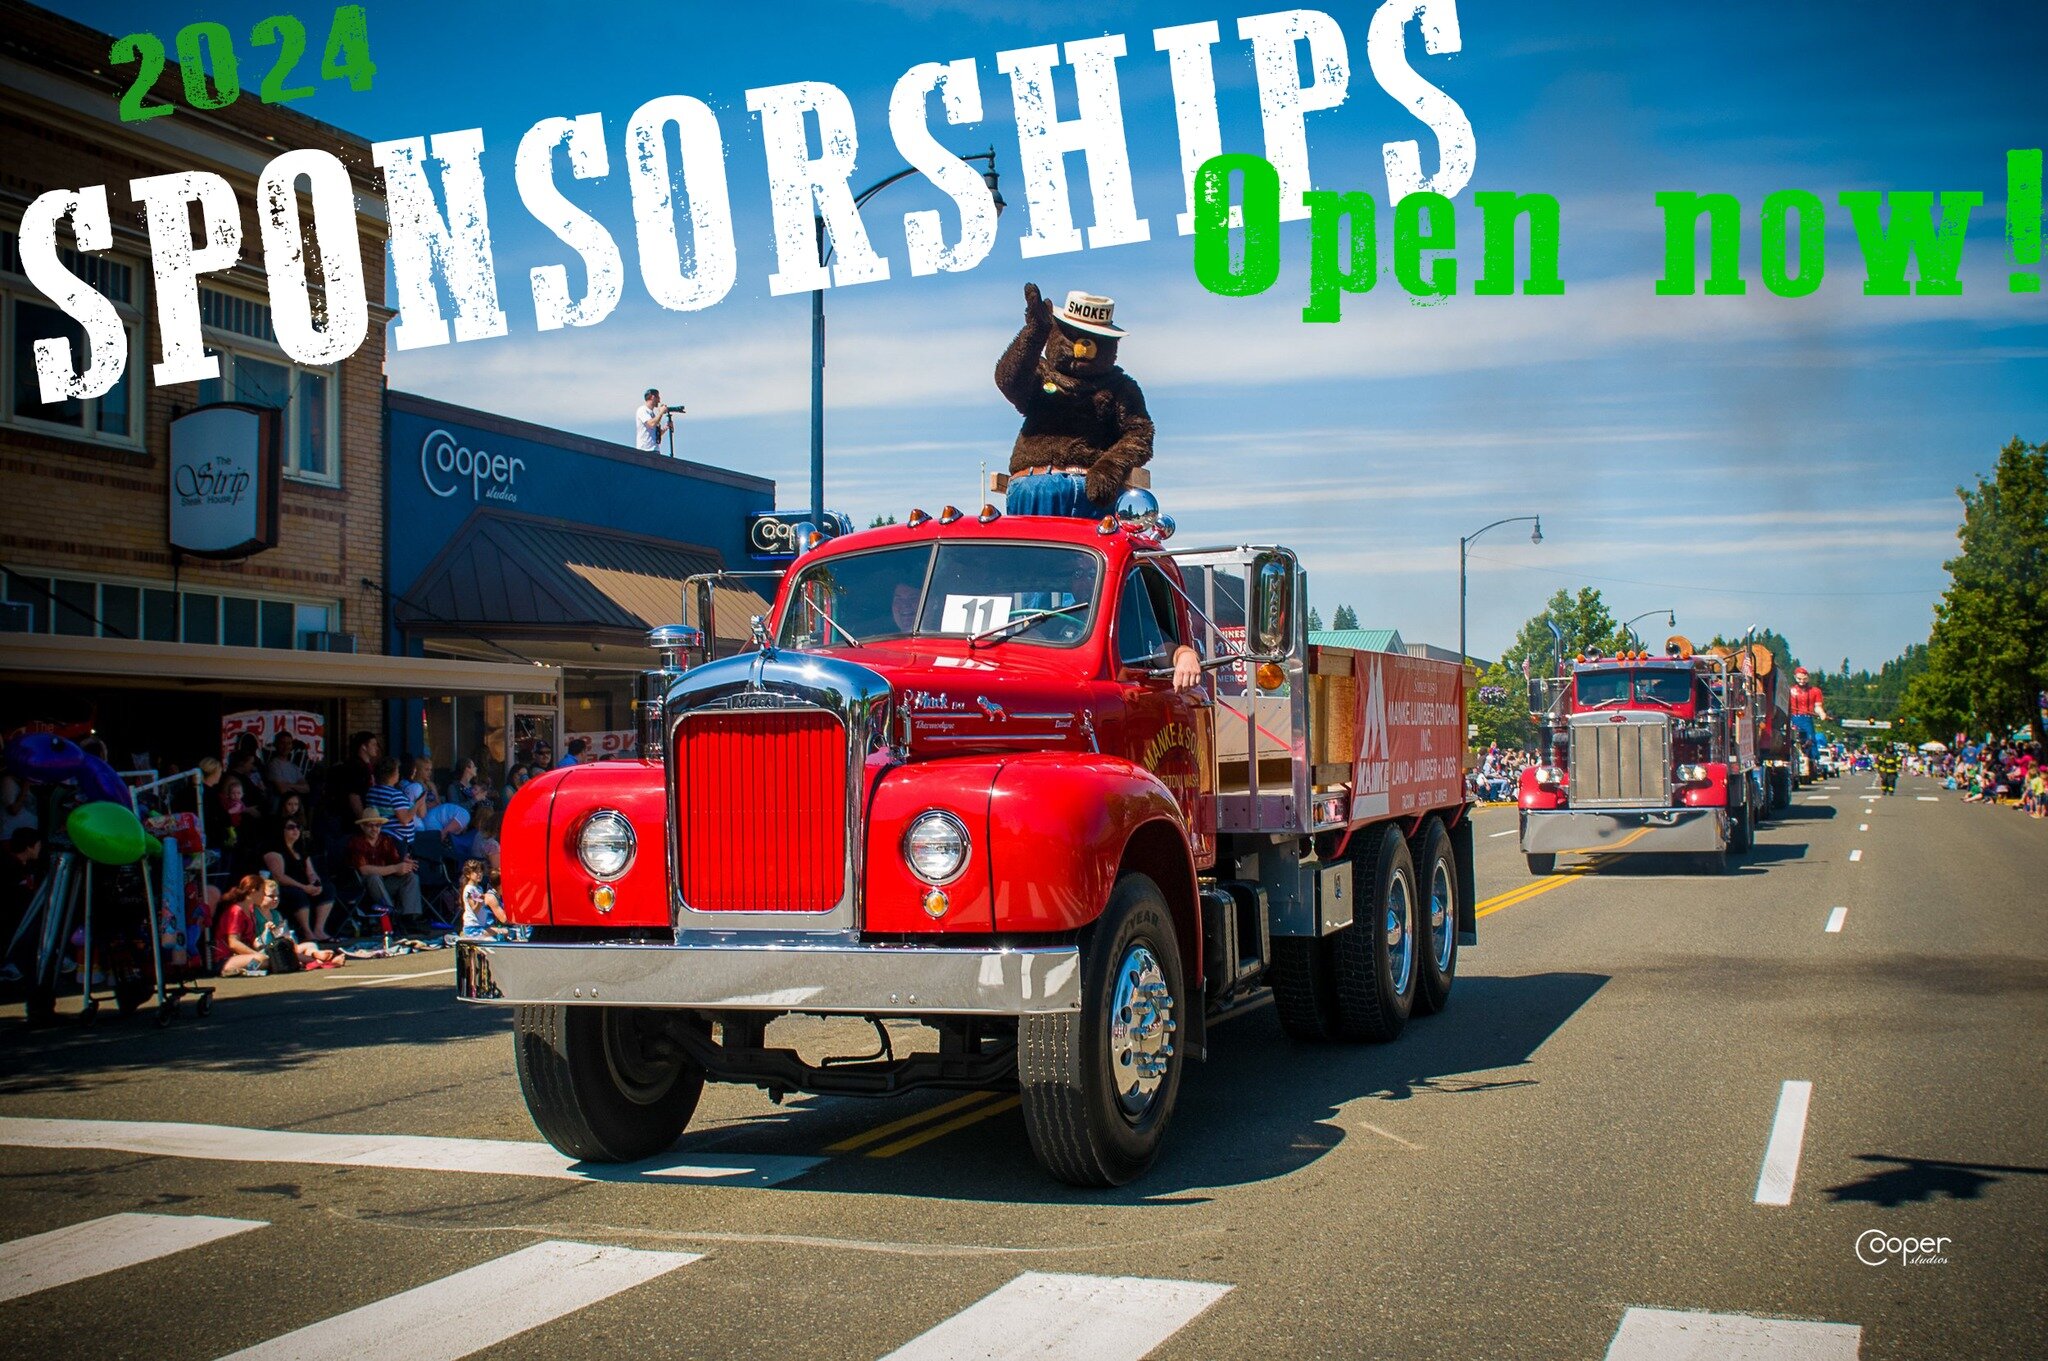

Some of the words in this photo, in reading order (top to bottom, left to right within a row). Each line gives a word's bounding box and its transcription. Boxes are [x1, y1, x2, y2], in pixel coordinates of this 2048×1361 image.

[1068, 301, 1111, 320] SMOKEY
[216, 456, 232, 465] The
[421, 429, 526, 501] Cooper
[176, 462, 249, 506] Strip
[485, 484, 518, 502] studios
[962, 598, 995, 633] 11
[914, 691, 948, 709] Mack
[1388, 701, 1410, 726] MANKE
[1411, 702, 1435, 726] LUMBER
[1143, 722, 1177, 772] MANKE
[1178, 722, 1184, 747] &
[1356, 761, 1389, 795] MANKE
[1392, 760, 1409, 786] LAND
[1414, 758, 1438, 783] LUMBER
[1441, 756, 1456, 779] LOGS
